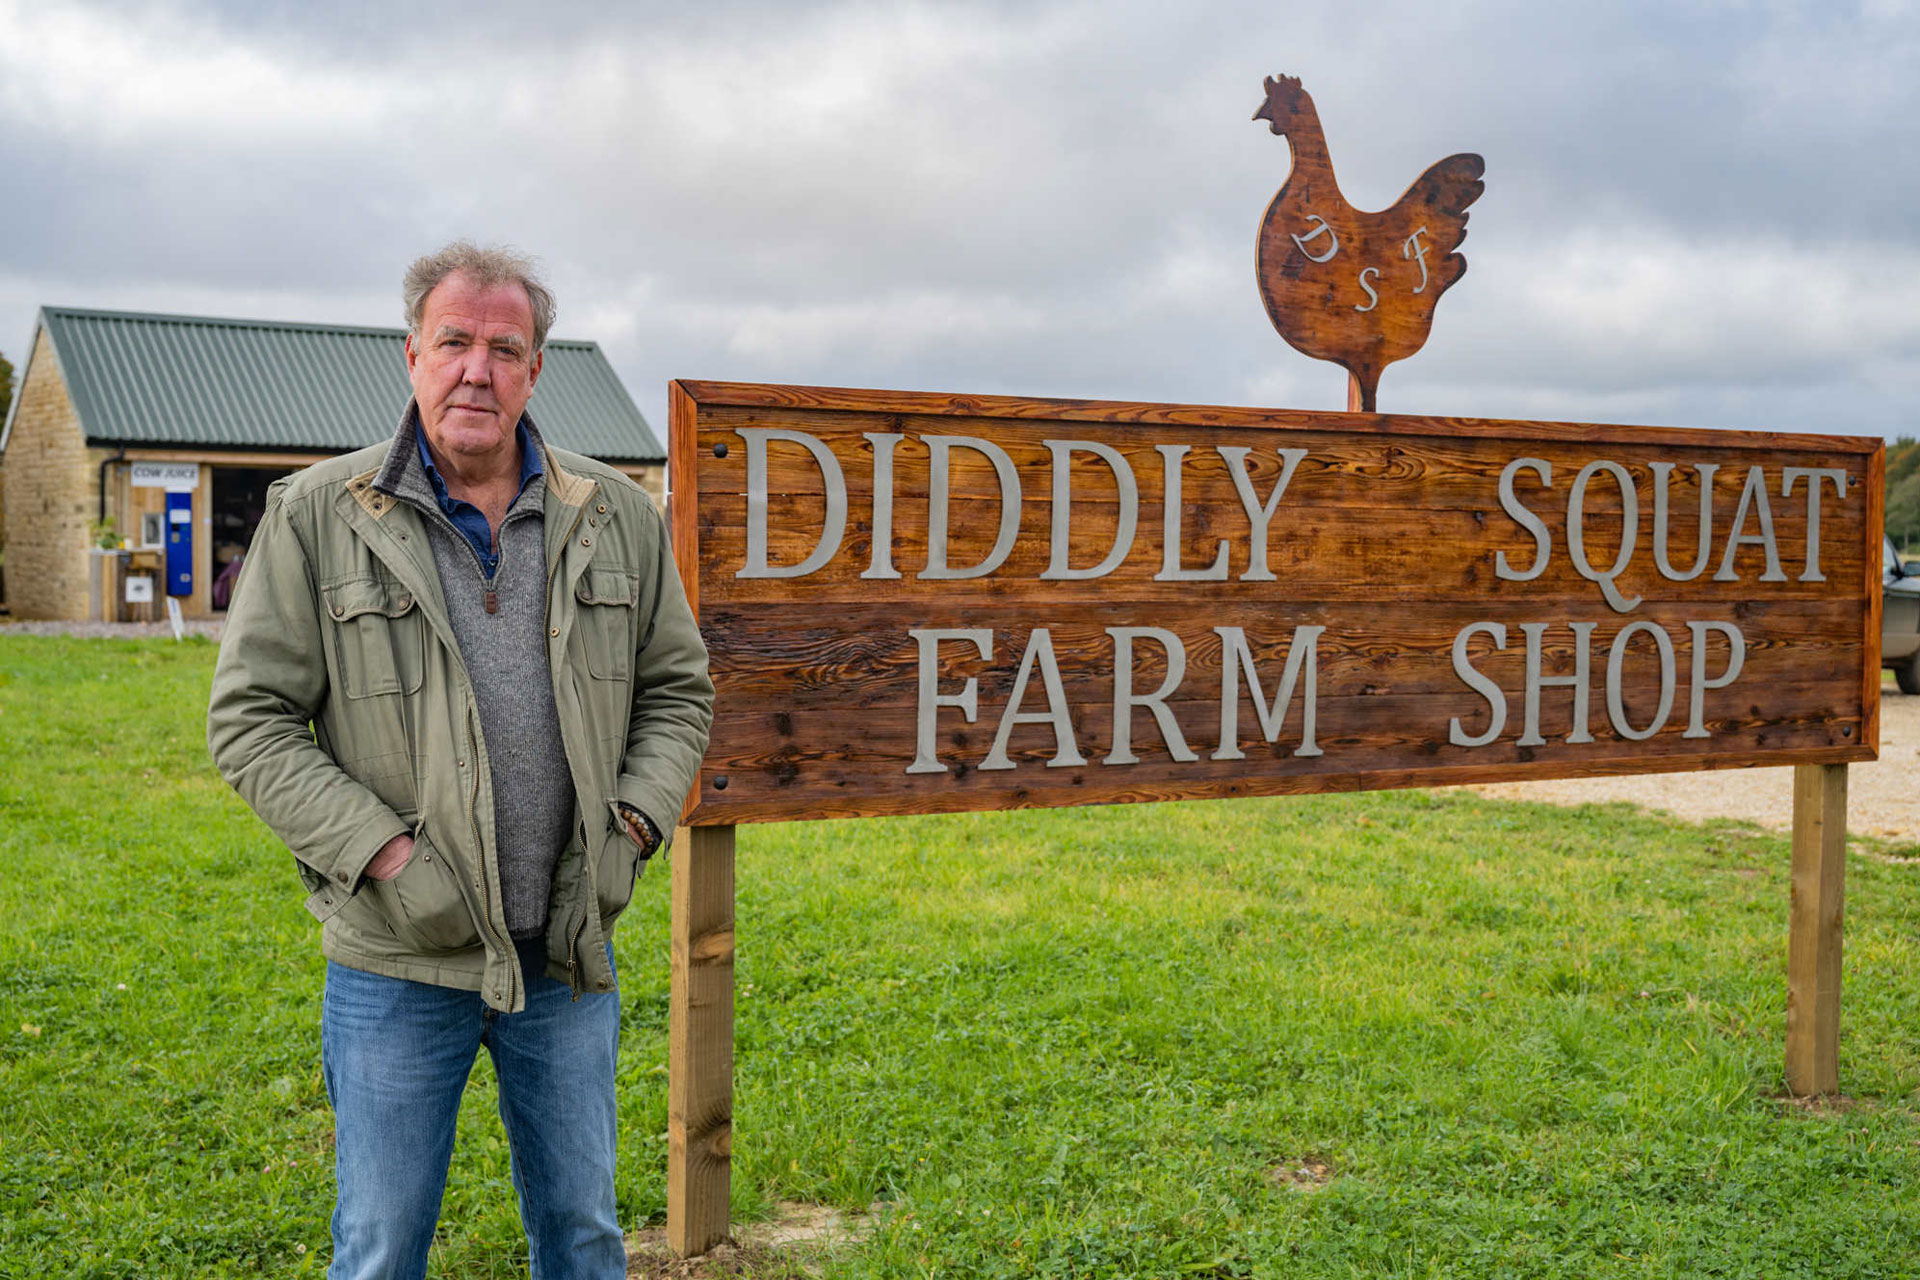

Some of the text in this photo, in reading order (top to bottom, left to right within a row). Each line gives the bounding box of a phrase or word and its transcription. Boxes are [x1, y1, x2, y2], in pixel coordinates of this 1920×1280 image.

[1291, 214, 1428, 312] D S F
[134, 467, 162, 478] COW
[735, 427, 1847, 613] DIDDLY SQUAT
[905, 620, 1746, 774] FARM SHOP
